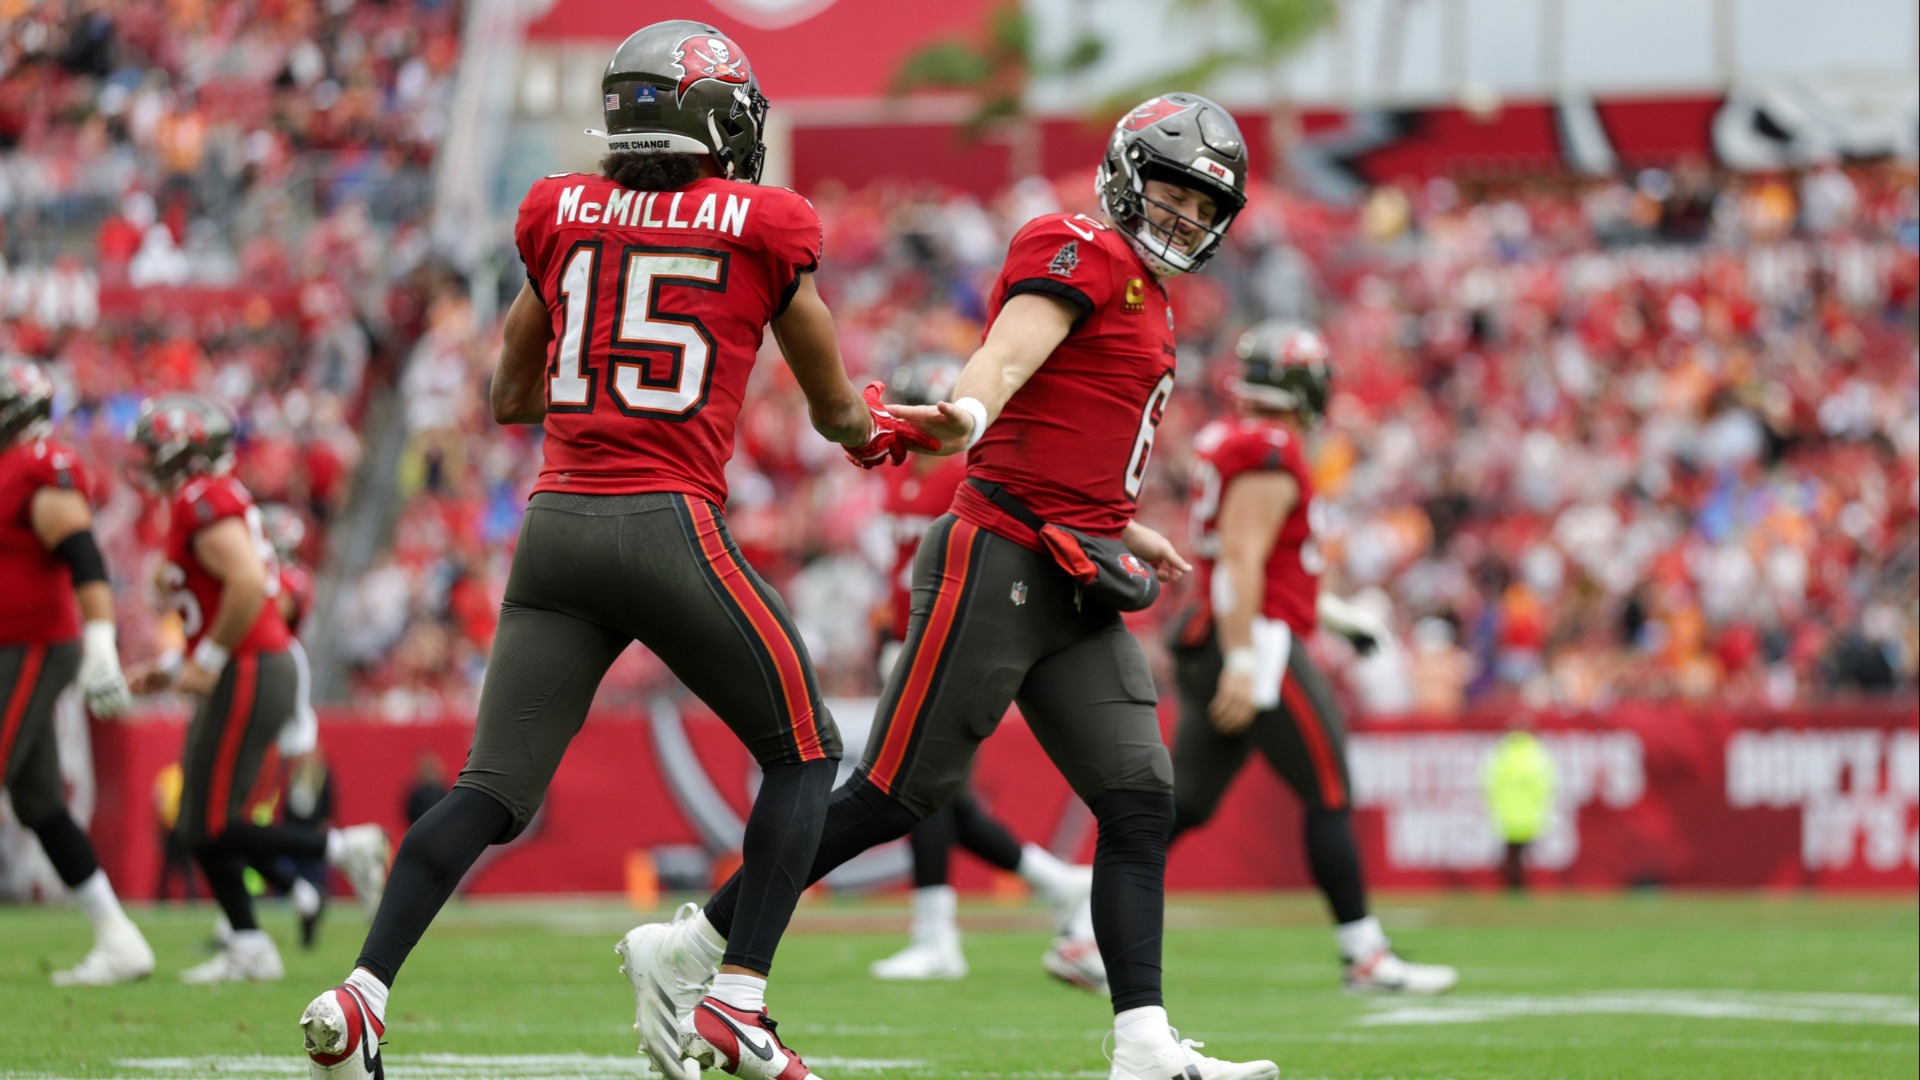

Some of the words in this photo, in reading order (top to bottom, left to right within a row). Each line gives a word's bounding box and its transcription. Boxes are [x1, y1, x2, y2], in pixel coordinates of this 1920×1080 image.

[631, 140, 670, 149] CHANGE
[547, 240, 730, 422] 15
[1126, 279, 1143, 304] C
[1123, 366, 1176, 504] 6
